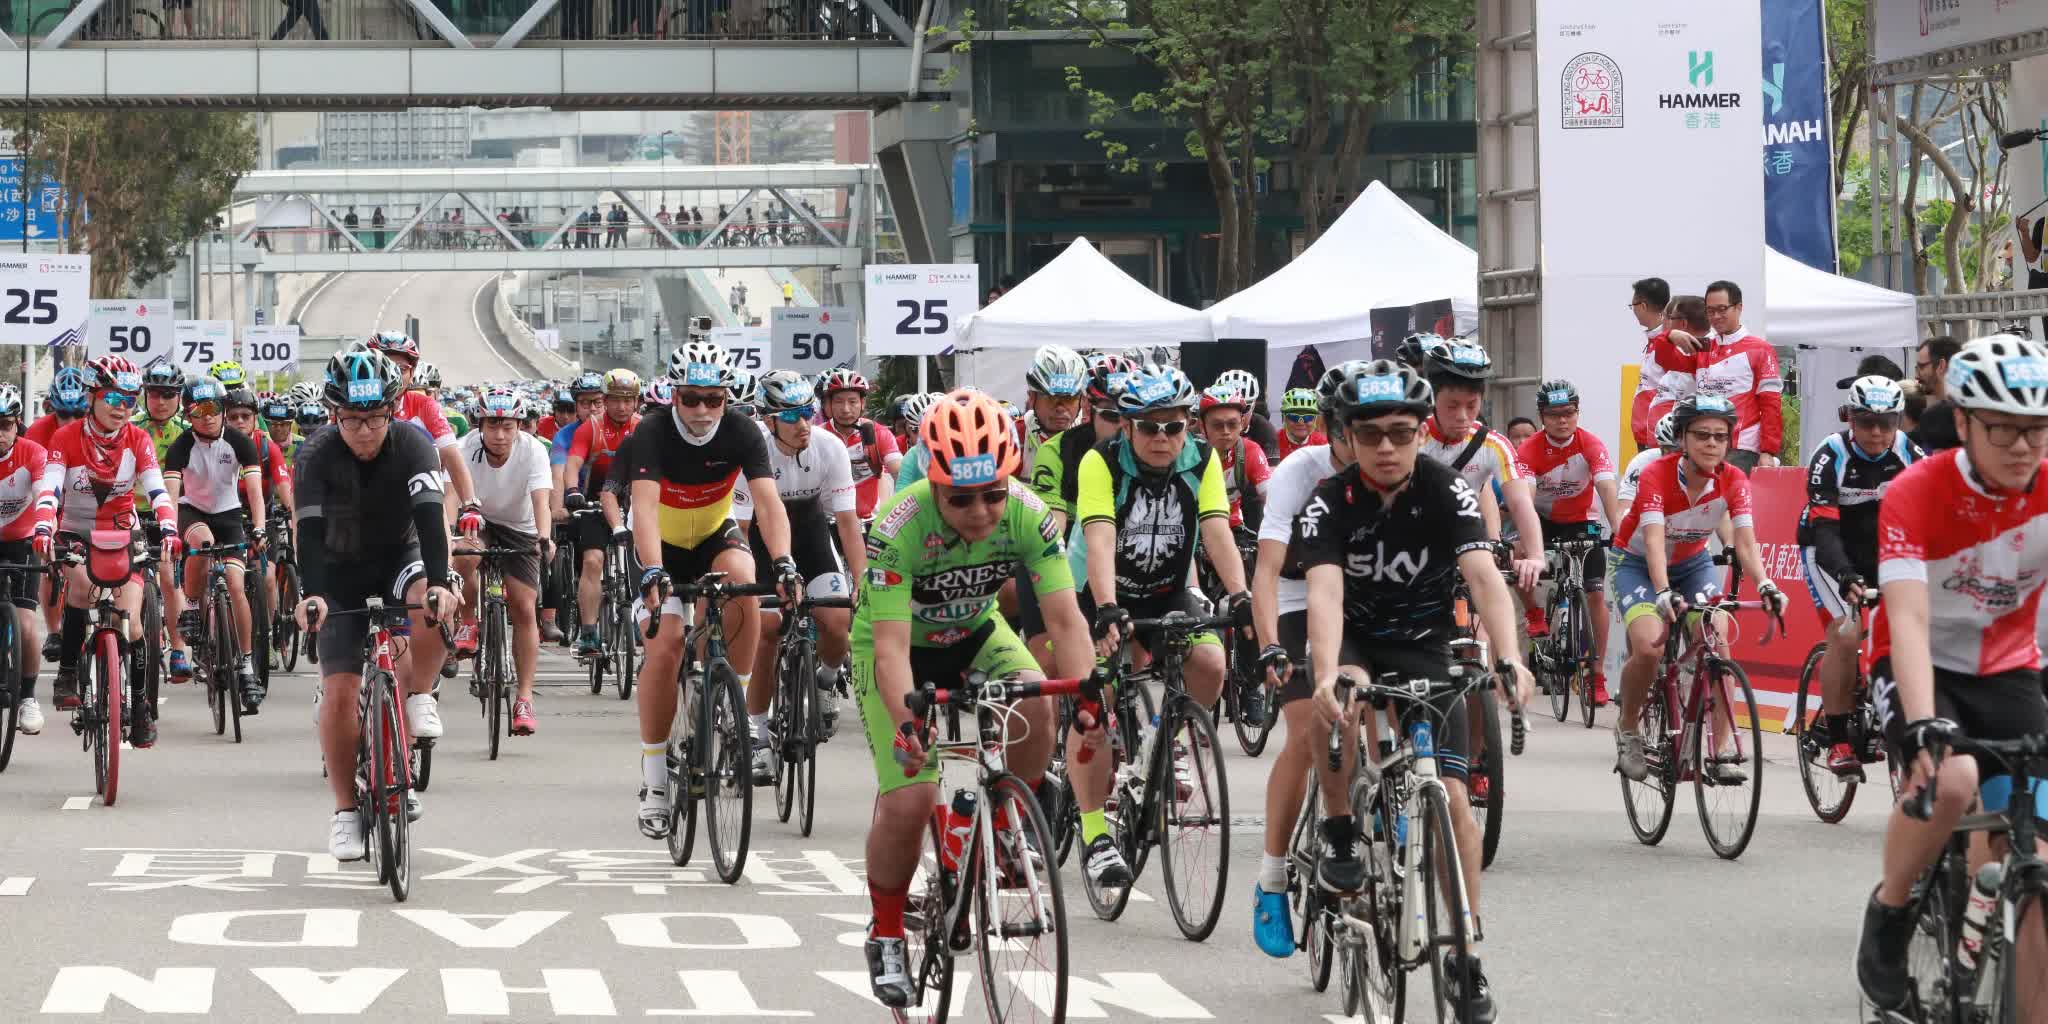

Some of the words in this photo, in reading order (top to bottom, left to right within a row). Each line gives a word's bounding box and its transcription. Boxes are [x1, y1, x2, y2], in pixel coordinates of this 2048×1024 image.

[1659, 93, 1741, 109] HAMMER
[1684, 112, 1721, 129] 香港
[886, 273, 917, 281] HAMMER
[5, 289, 58, 325] 25
[895, 299, 949, 335] 25
[110, 326, 151, 352] 50
[793, 333, 834, 360] 50
[182, 342, 214, 363] 75
[251, 343, 291, 361] 100
[729, 348, 761, 369] 75
[350, 384, 380, 397] 6384
[953, 460, 994, 480] 5876
[941, 584, 987, 604] VINI
